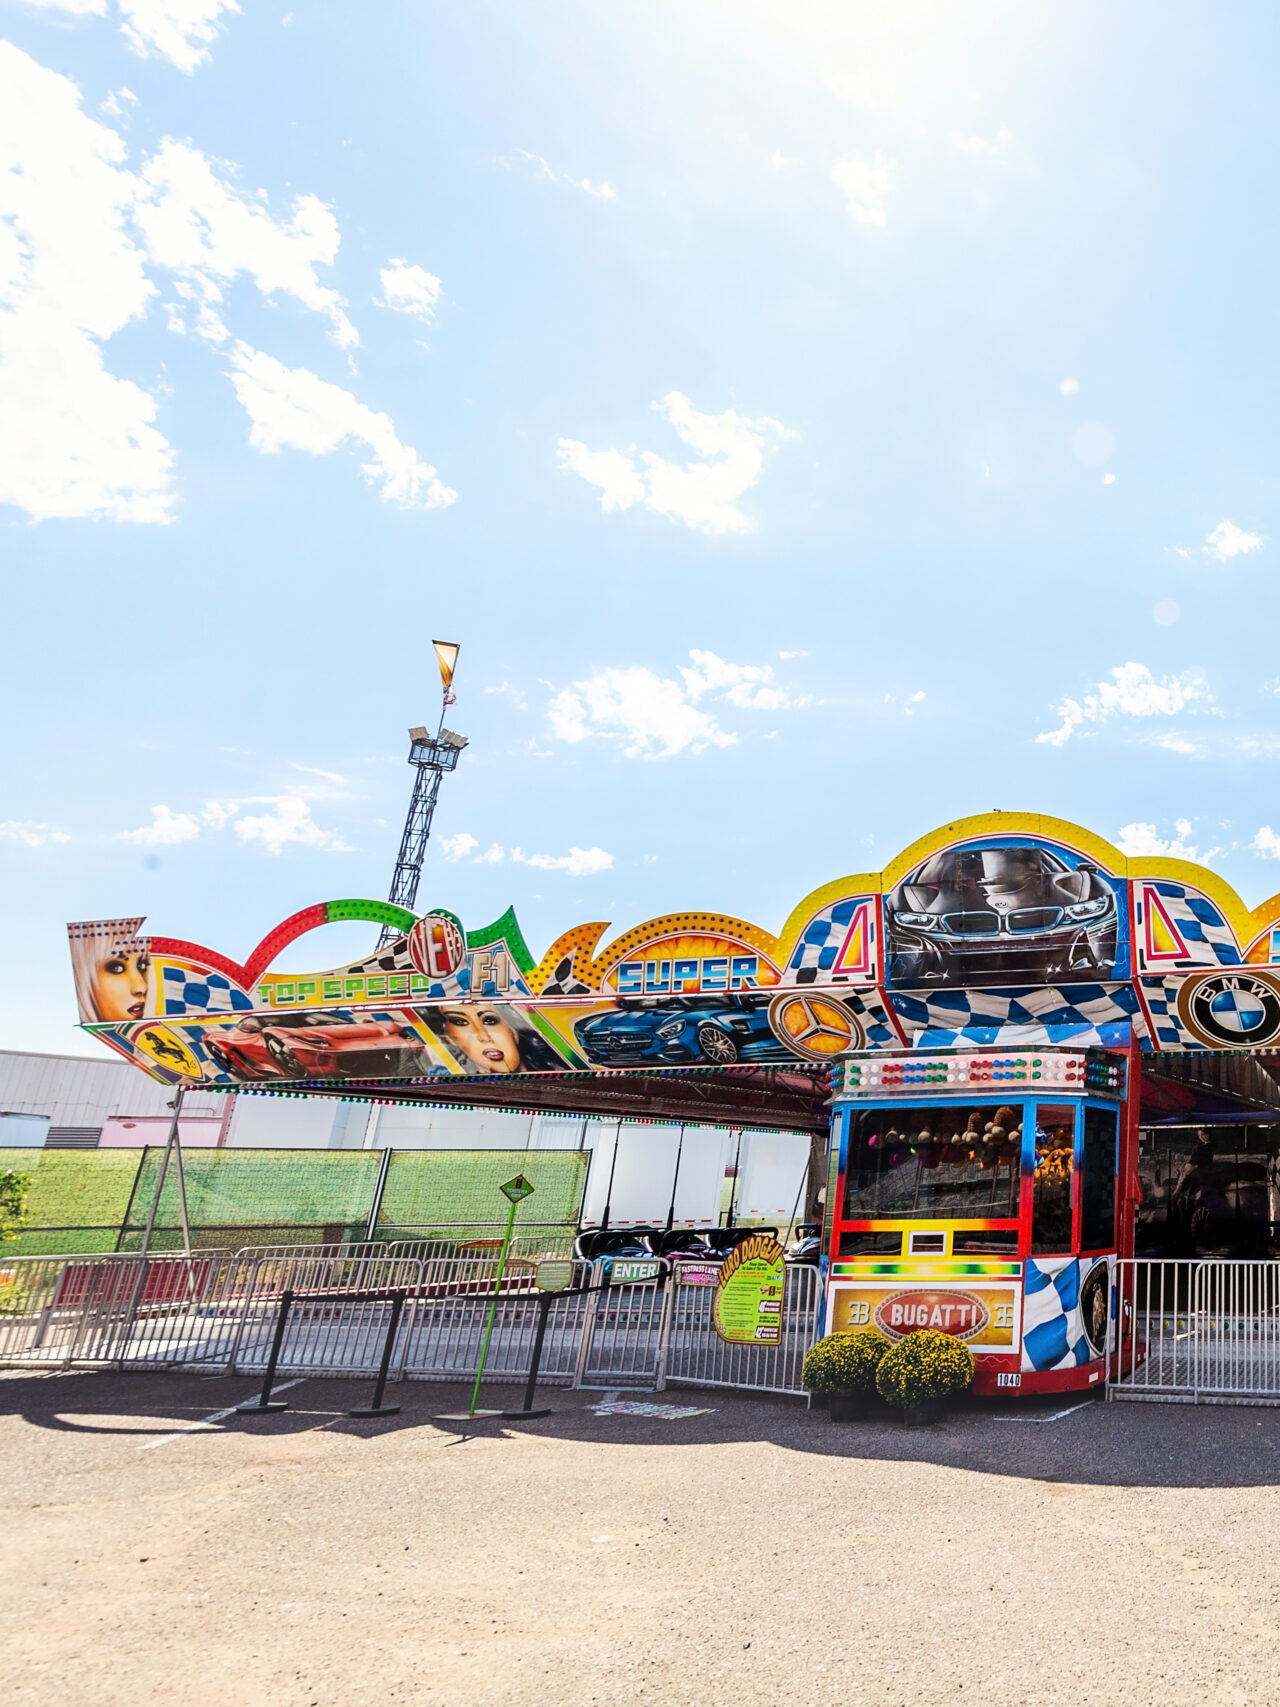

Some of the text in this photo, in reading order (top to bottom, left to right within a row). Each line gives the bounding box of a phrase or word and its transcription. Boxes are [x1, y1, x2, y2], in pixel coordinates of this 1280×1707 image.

[411, 917, 463, 978] NEW
[471, 950, 511, 993] F1
[616, 956, 760, 994] SUPER
[257, 974, 430, 1004] TOP SPEED
[1197, 977, 1272, 1003] BMW
[613, 1262, 657, 1278] ENTER
[681, 1265, 705, 1274] FASTPASS
[718, 1236, 784, 1290] EURO DODGEM
[890, 1303, 978, 1328] BUGATTI
[999, 1374, 1020, 1386] 1040
